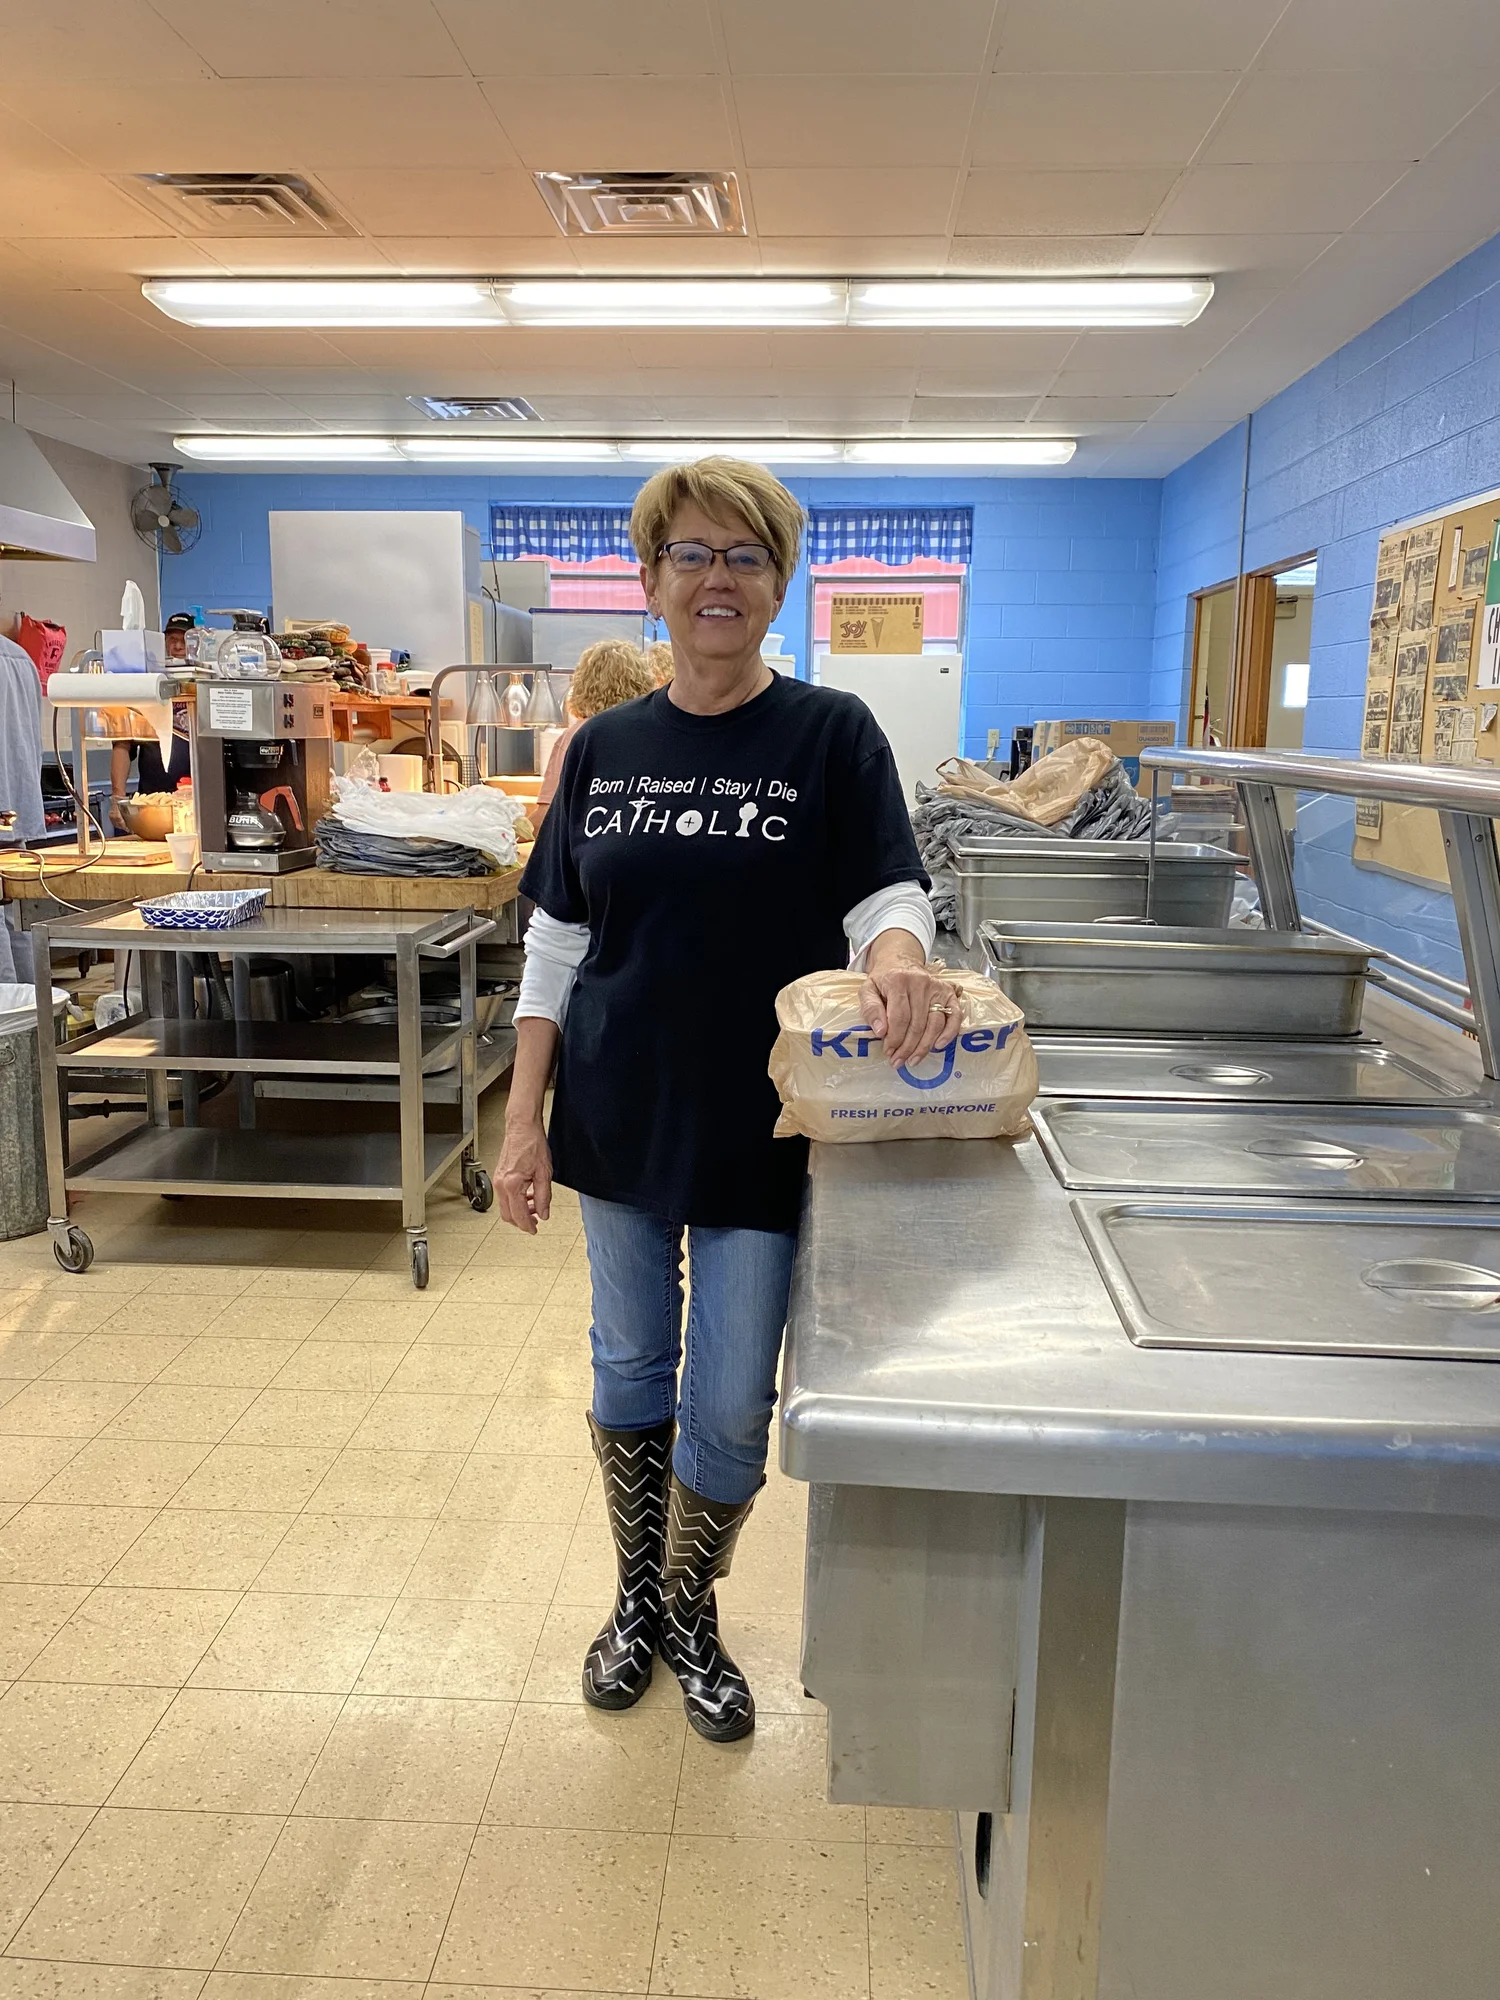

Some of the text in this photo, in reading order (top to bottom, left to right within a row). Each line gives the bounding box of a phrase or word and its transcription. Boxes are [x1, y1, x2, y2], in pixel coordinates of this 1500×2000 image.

[589, 777, 624, 796] Born
[636, 776, 696, 794] Raised
[711, 777, 752, 800] Stay
[767, 780, 798, 802] Die
[810, 1021, 1019, 1091] Krger
[830, 1109, 878, 1119] FRESH
[883, 1107, 915, 1118] FOR
